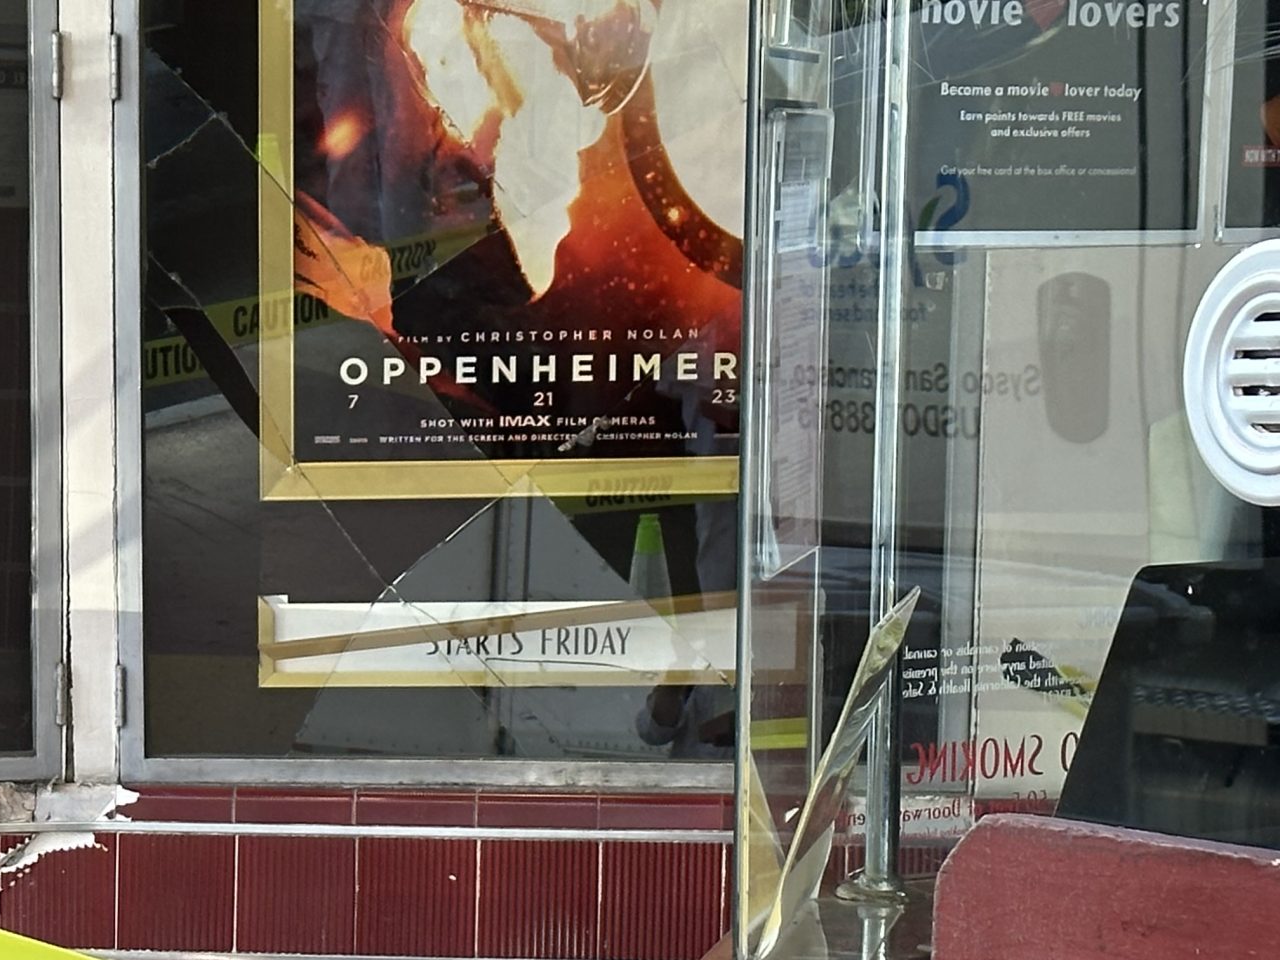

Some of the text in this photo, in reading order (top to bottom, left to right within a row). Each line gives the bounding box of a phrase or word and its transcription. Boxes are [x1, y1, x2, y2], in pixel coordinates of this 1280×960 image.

[1066, 0, 1181, 28] lovers
[940, 82, 1142, 102] Become a movie lover today
[960, 110, 1121, 124] Earn points towards FREE movies
[990, 127, 1091, 137] and exclusive offers
[461, 330, 612, 343] CHRISTOPHER
[627, 328, 699, 340] NOLAN
[340, 352, 737, 385] OPPENHEIMER
[348, 389, 736, 409] 7 21 23
[420, 419, 455, 428] SHOT
[460, 418, 494, 427] WITH
[499, 415, 551, 427] IMAX
[556, 417, 587, 426] FILM
[379, 436, 422, 444] WRITTEN
[507, 434, 528, 442] AND
[665, 431, 698, 439] NOLAN
[541, 626, 631, 656] FRIDAY
